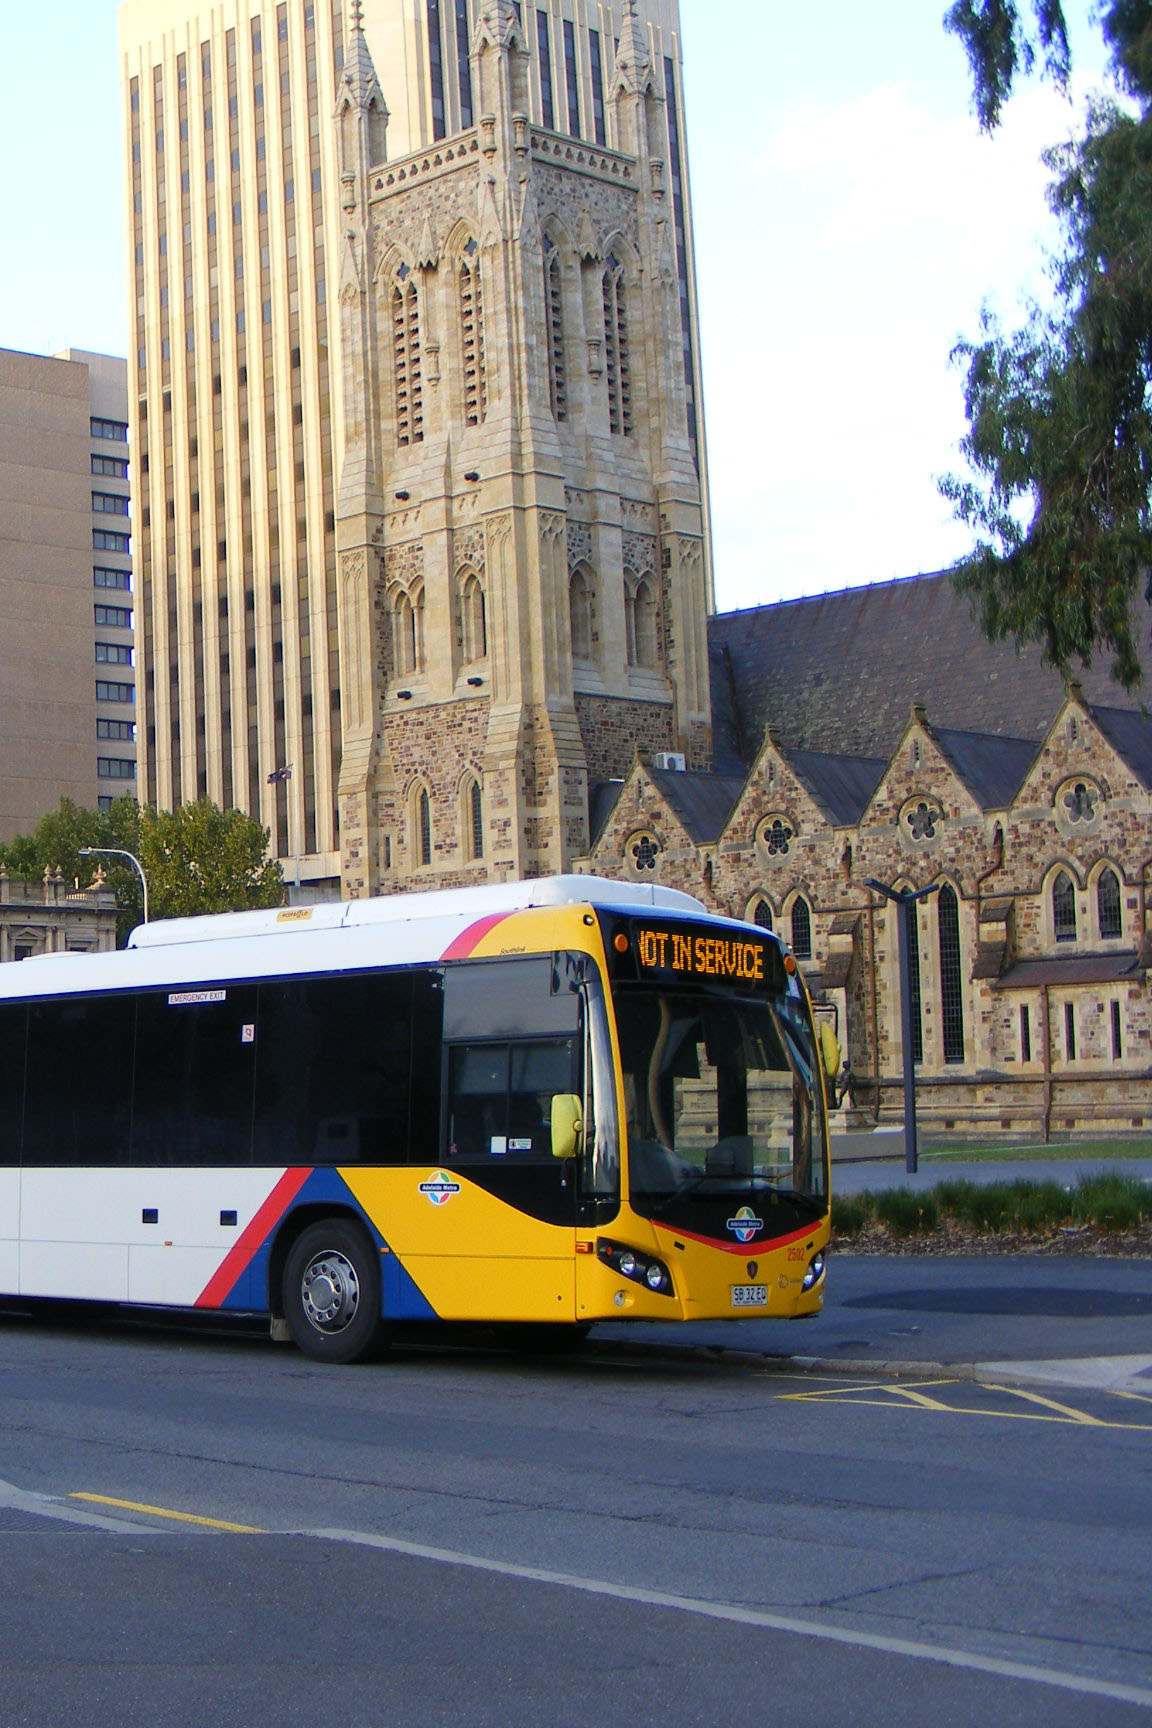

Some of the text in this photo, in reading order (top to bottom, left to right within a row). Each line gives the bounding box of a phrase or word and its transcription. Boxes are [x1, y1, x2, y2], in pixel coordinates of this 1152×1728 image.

[672, 934, 691, 970] IN
[695, 937, 763, 978] SERVICE
[170, 991, 223, 1003] EMERGENCY EXIT
[787, 1248, 805, 1262] 2502
[734, 1288, 744, 1300] SB
[746, 1288, 754, 1300] 32
